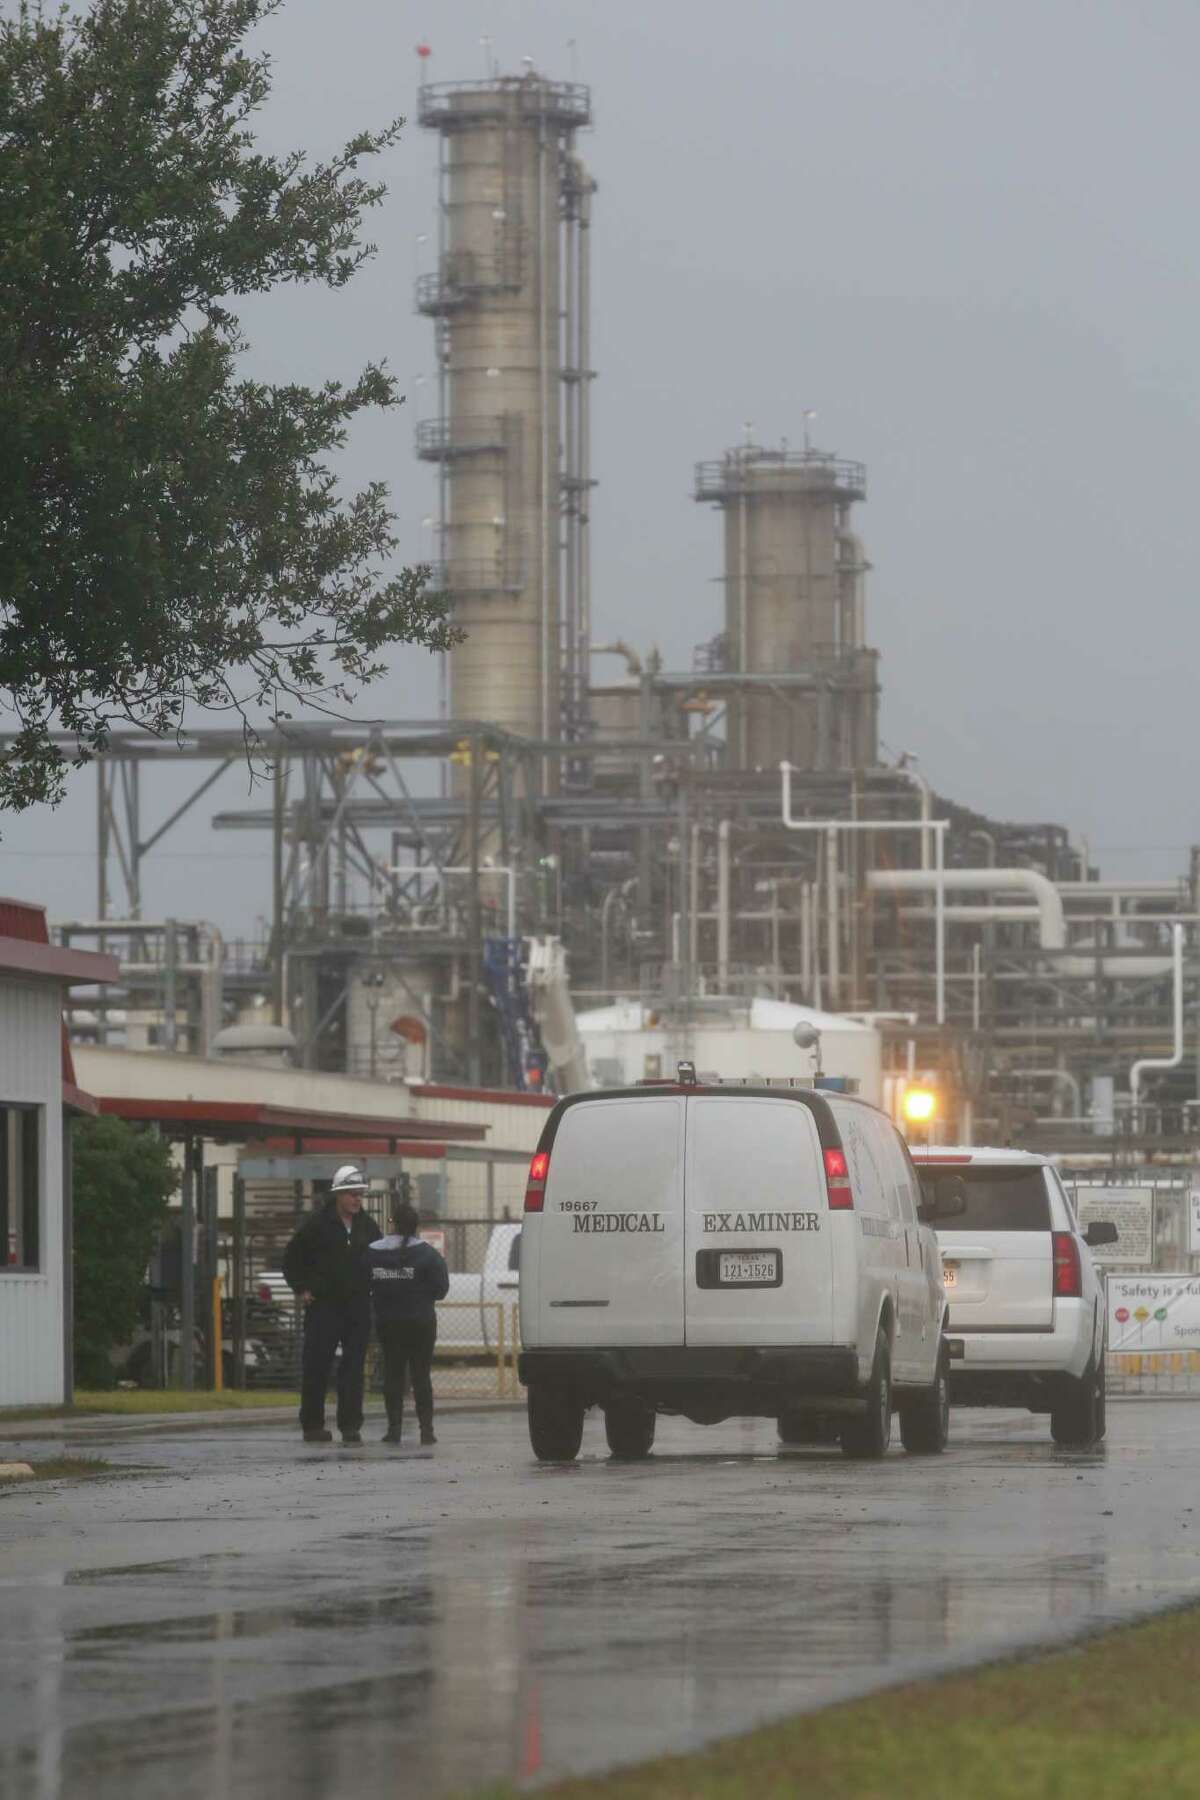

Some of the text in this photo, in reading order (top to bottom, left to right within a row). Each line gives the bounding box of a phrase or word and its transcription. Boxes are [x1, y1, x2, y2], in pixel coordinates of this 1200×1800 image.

[560, 1201, 598, 1212] 19667
[573, 1212, 820, 1232] MEDICAL EXAMINER
